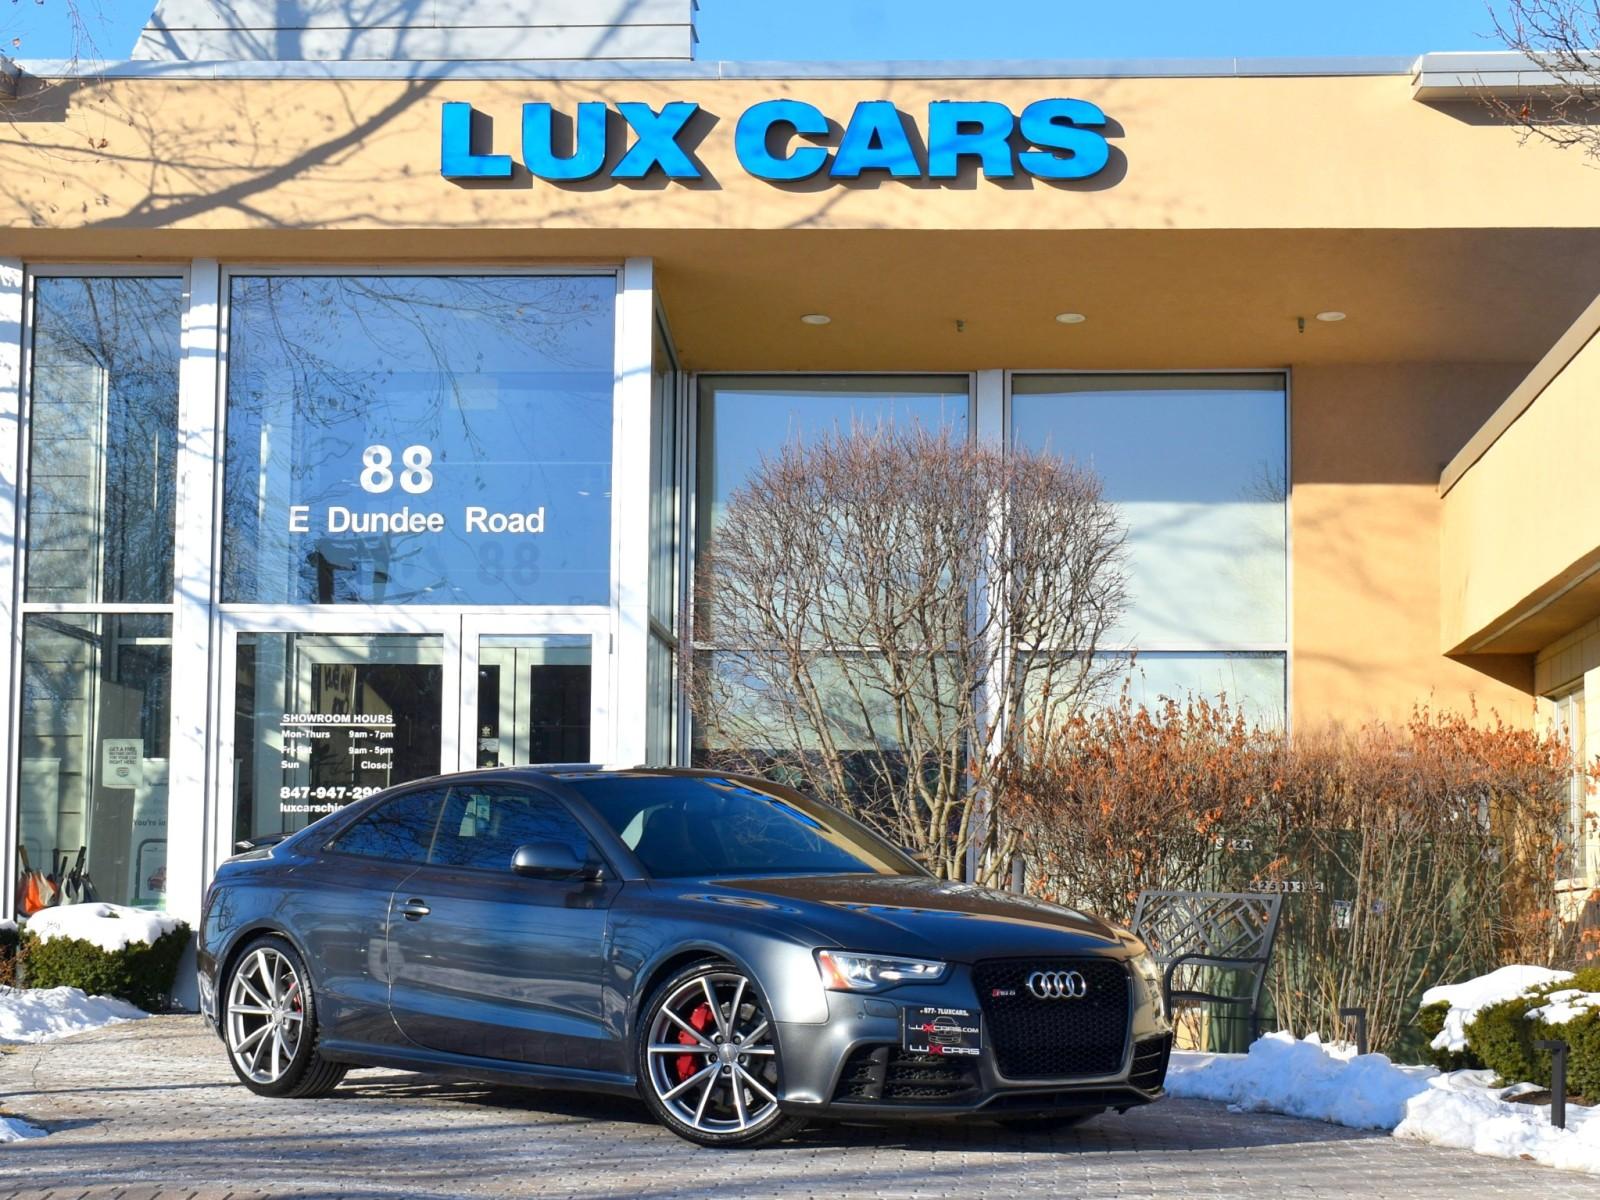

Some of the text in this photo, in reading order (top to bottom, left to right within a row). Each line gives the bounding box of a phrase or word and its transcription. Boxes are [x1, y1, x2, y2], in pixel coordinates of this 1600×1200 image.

[440, 98, 1110, 182] LUX CARS
[359, 444, 434, 494] 88
[289, 506, 545, 533] E Dundee Road
[282, 714, 393, 723] SHOWROOM HOURS
[281, 730, 331, 739] Mon-Thurs
[348, 730, 368, 739] 9am
[374, 730, 394, 740] 7pm
[348, 746, 368, 755] 9am
[374, 746, 394, 756] 5pm
[281, 760, 393, 770] Sun Closed
[909, 1043, 980, 1056] LUXCARS
